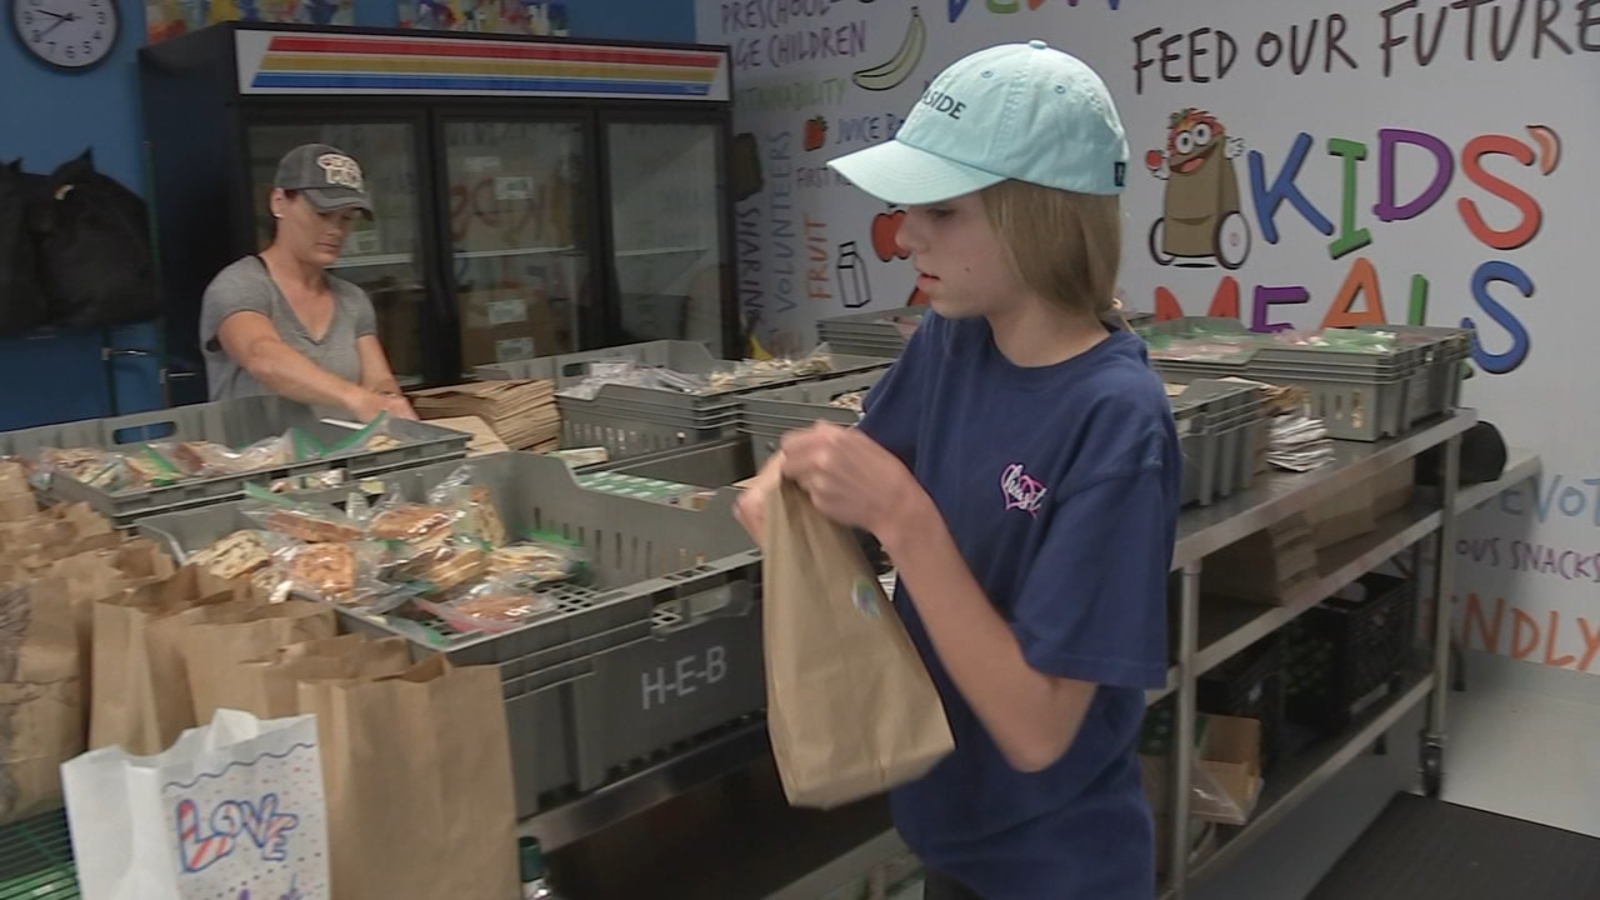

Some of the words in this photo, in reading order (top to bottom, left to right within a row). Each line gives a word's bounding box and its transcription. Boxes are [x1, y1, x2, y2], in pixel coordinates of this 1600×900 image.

[733, 37, 762, 71] GE
[769, 19, 867, 68] CHILDREN
[1131, 27, 1237, 95] FEED
[1256, 13, 1358, 75] OUR
[1379, 0, 1600, 77] FUTURE
[769, 131, 798, 313] VOLUNTEERS
[1248, 124, 1562, 260] KIDS'
[805, 212, 833, 299] FRUIT
[1456, 537, 1501, 567] OUS
[1459, 591, 1600, 672] NDLY
[640, 645, 728, 711] H-E-B
[177, 792, 299, 873] LOVE
